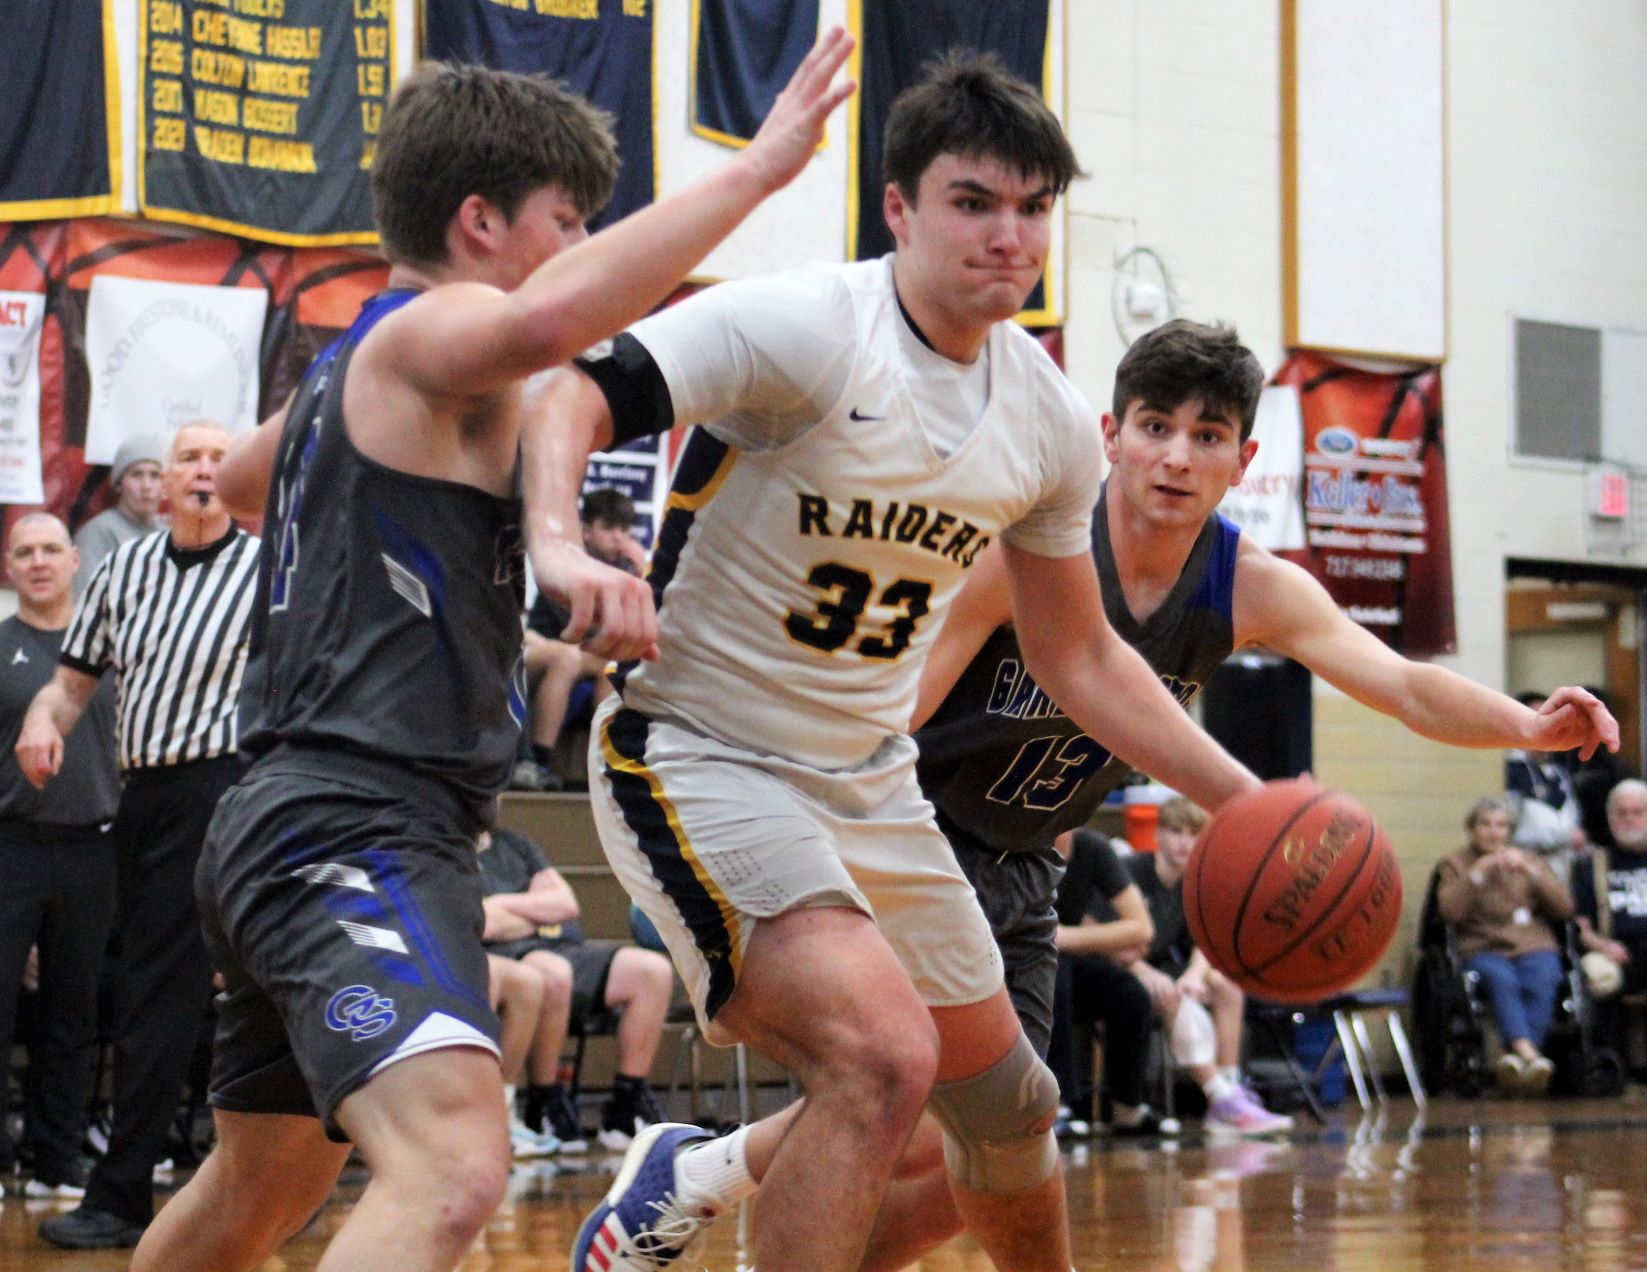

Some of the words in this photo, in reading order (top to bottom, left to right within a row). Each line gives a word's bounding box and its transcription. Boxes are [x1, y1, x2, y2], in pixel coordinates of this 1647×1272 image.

[797, 492, 990, 569] RAIDERS
[783, 561, 936, 663] 33
[985, 733, 1114, 811] 13
